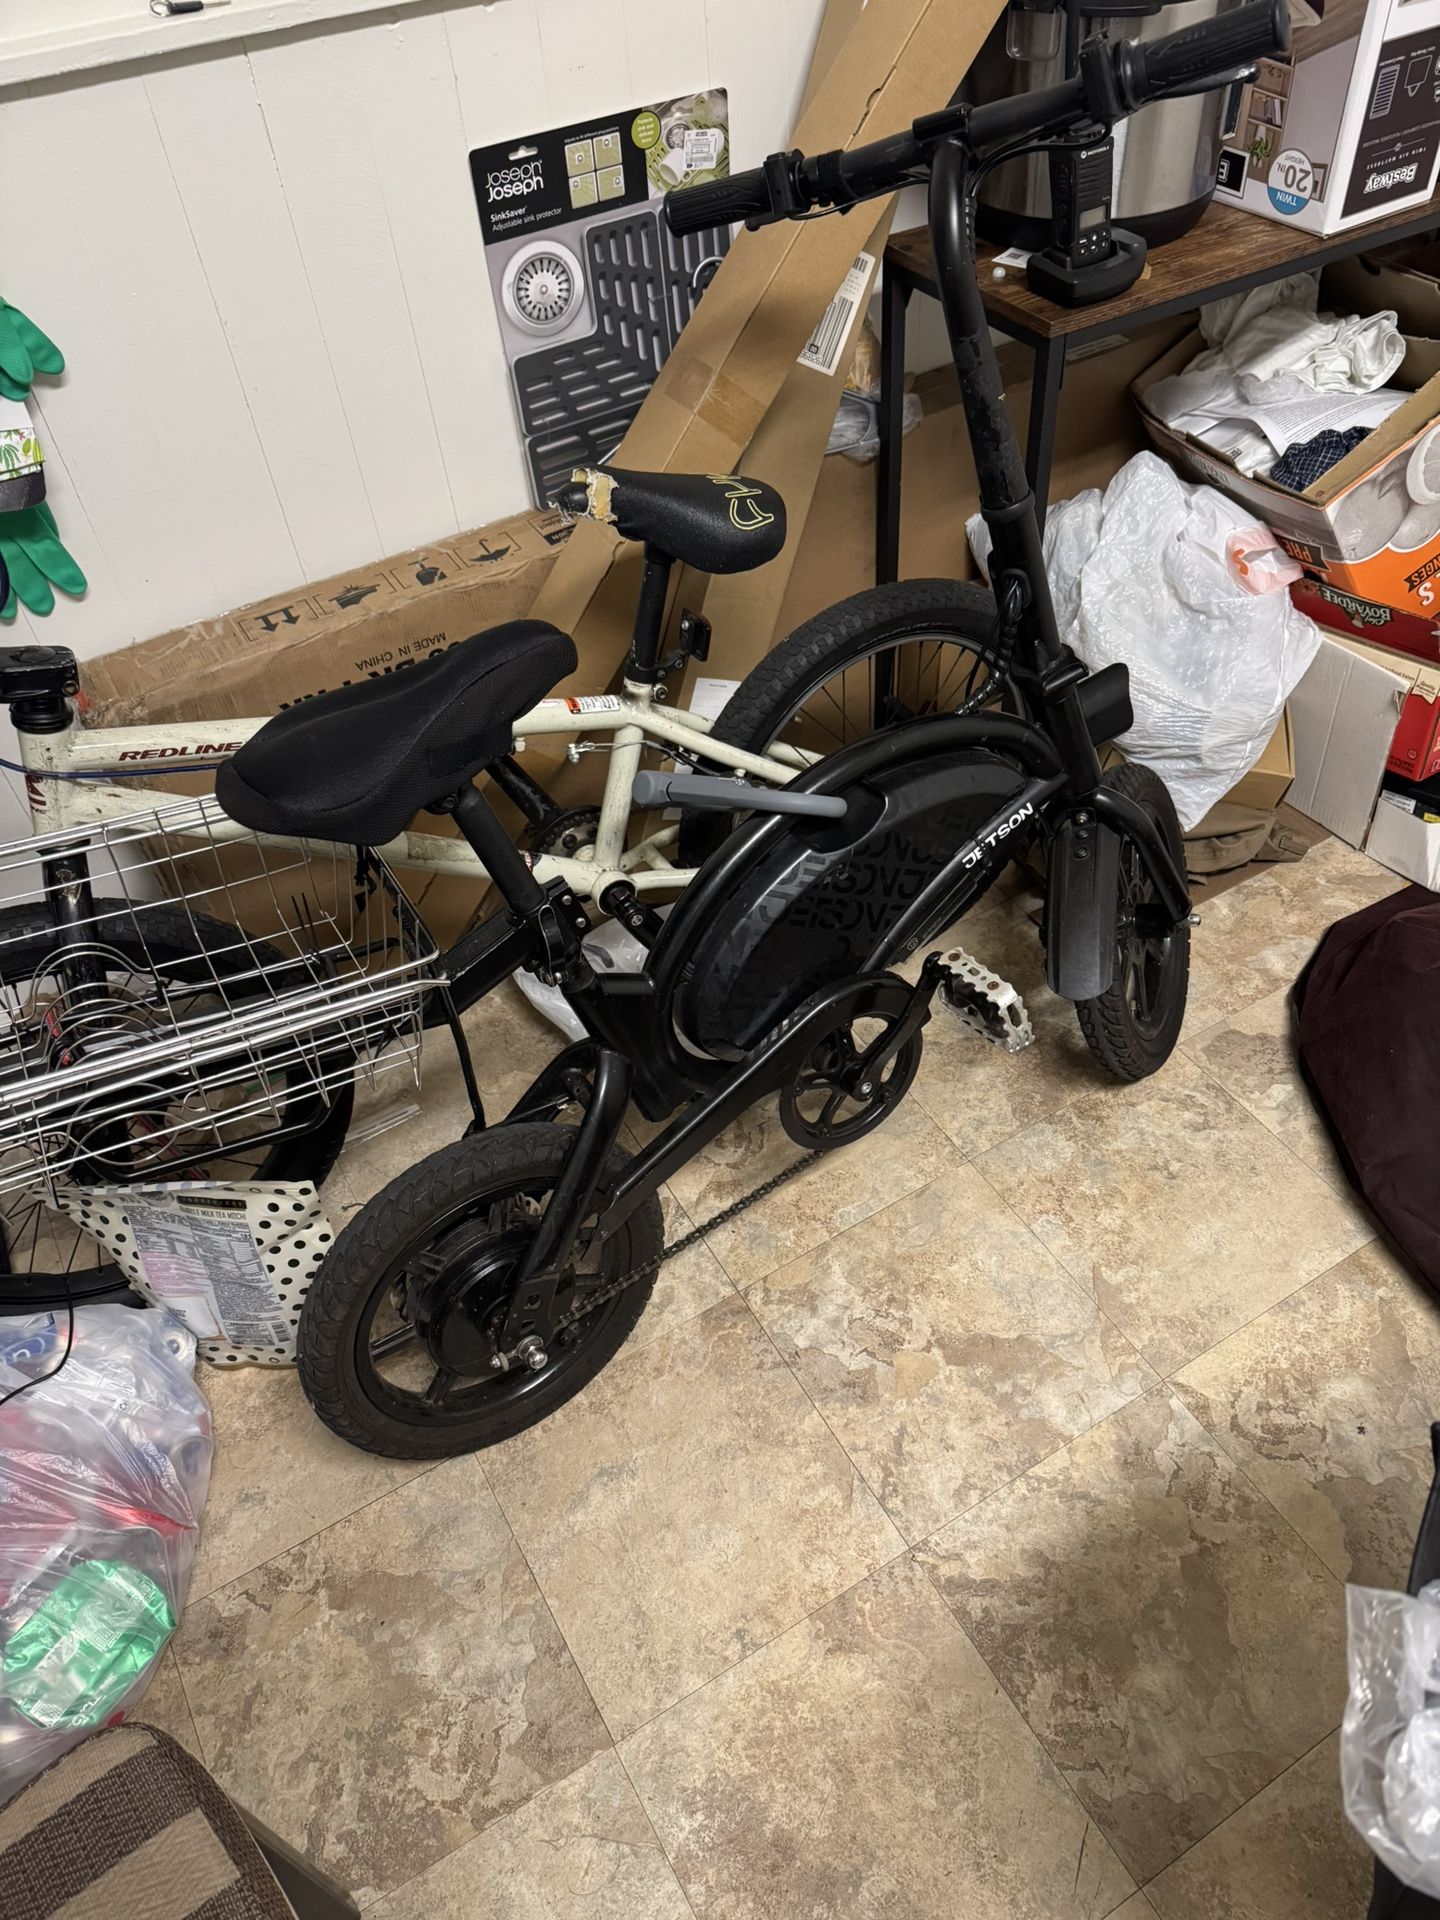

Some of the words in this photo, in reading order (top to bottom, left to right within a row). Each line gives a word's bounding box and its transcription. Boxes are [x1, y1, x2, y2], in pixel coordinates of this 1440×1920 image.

[1284, 154, 1305, 166] HEIGHT
[485, 160, 542, 188] Joseph
[1283, 164, 1311, 193] 20
[1363, 162, 1418, 194] Bestway
[488, 175, 544, 203] Joseph
[1276, 190, 1298, 207] TWIN
[492, 218, 523, 232] Adjustable
[524, 214, 536, 224] sink
[536, 208, 562, 221] protector
[1321, 587, 1391, 621] BOYARDEE
[1363, 613, 1385, 627] Chef
[398, 644, 411, 657] IN
[413, 631, 447, 652] MADE
[355, 651, 393, 672] CHINA
[118, 741, 243, 761] REDLINE
